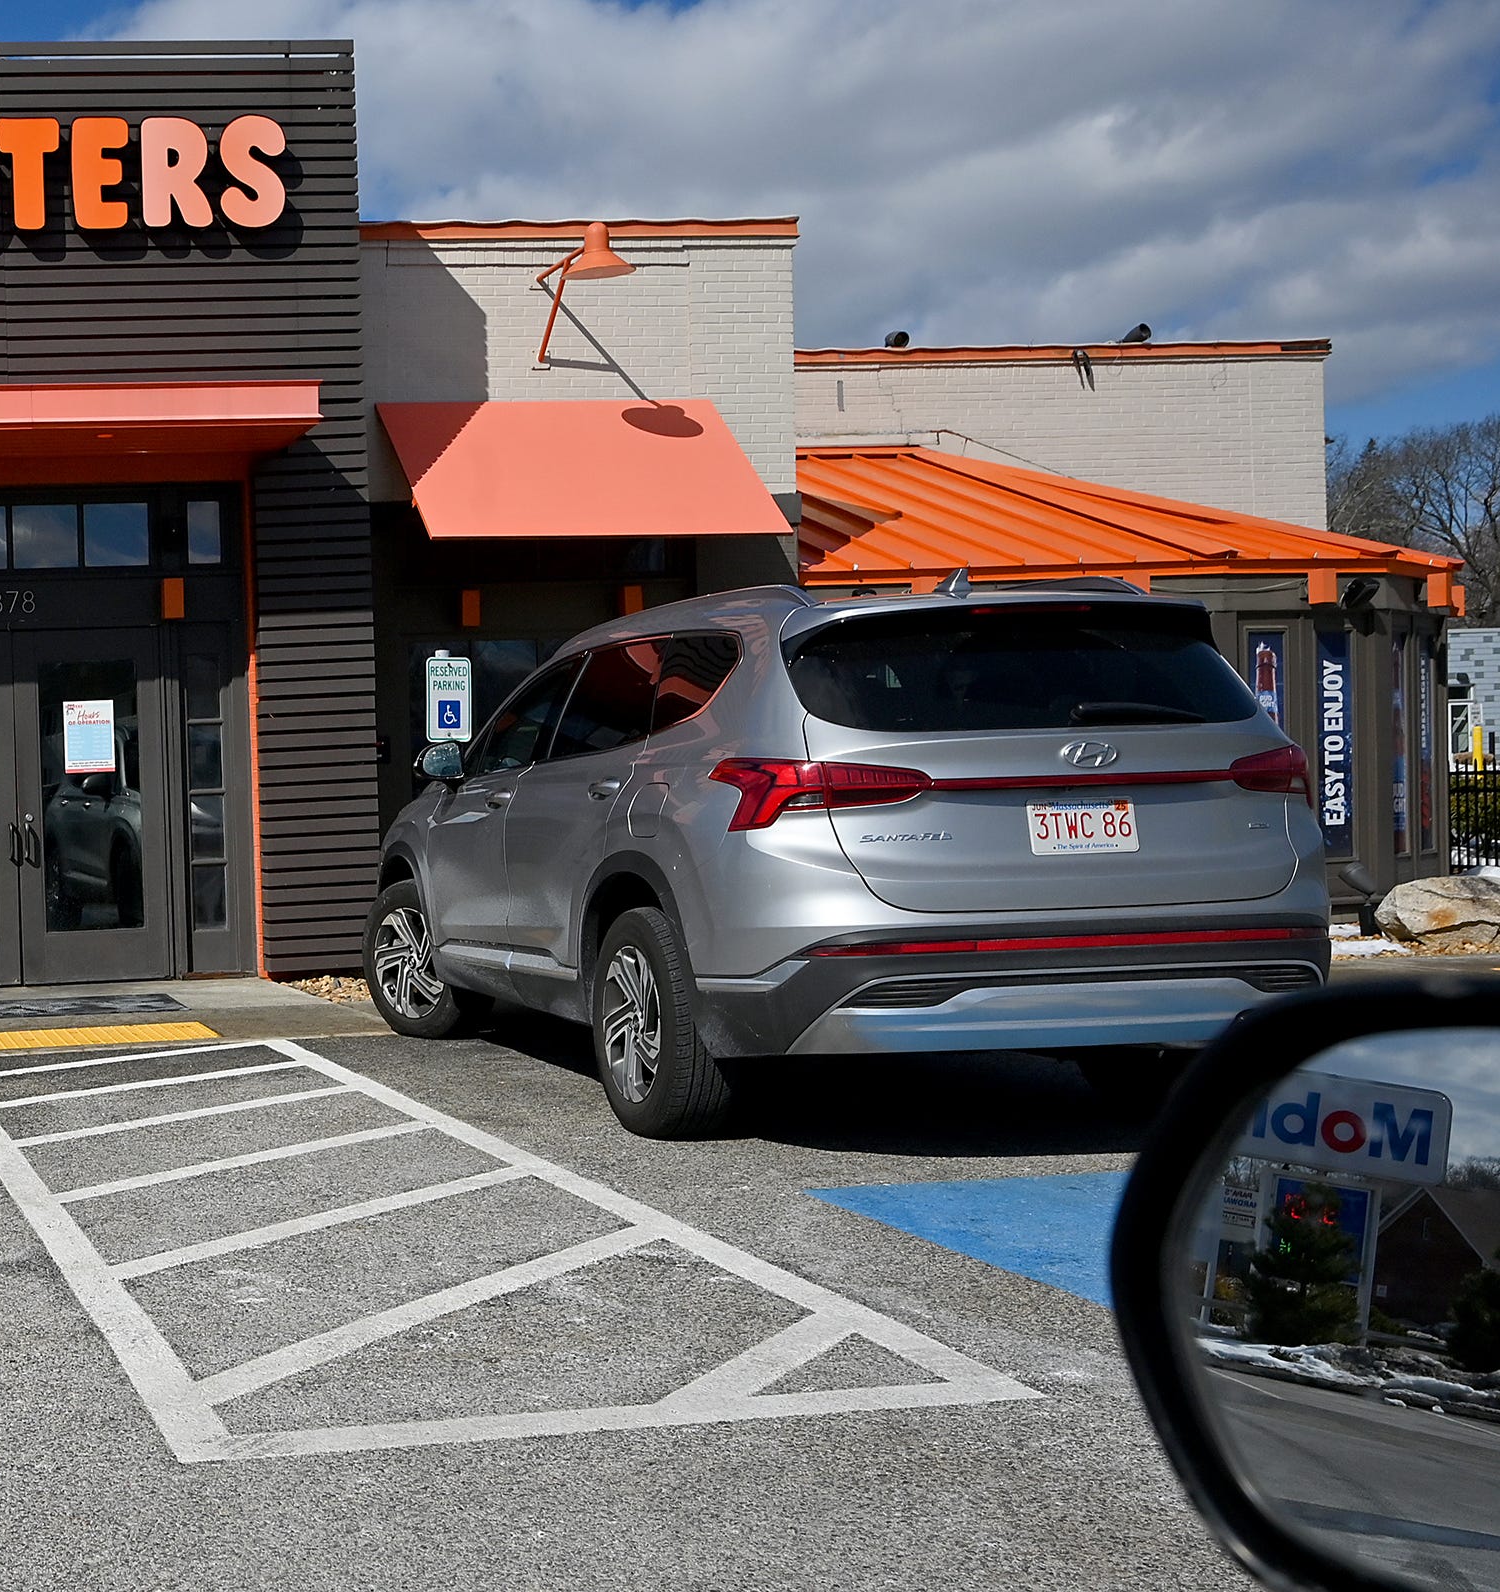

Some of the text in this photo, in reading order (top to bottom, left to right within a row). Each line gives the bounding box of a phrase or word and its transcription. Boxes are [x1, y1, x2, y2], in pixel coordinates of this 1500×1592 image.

[431, 666, 468, 677] RESERVED
[432, 680, 466, 691] PARKING
[1323, 659, 1345, 826] EASY TO ENJOY
[1032, 800, 1109, 811] JUN Massachusetts
[1115, 802, 1126, 811] 25
[1034, 811, 1132, 840] 3TWC 86
